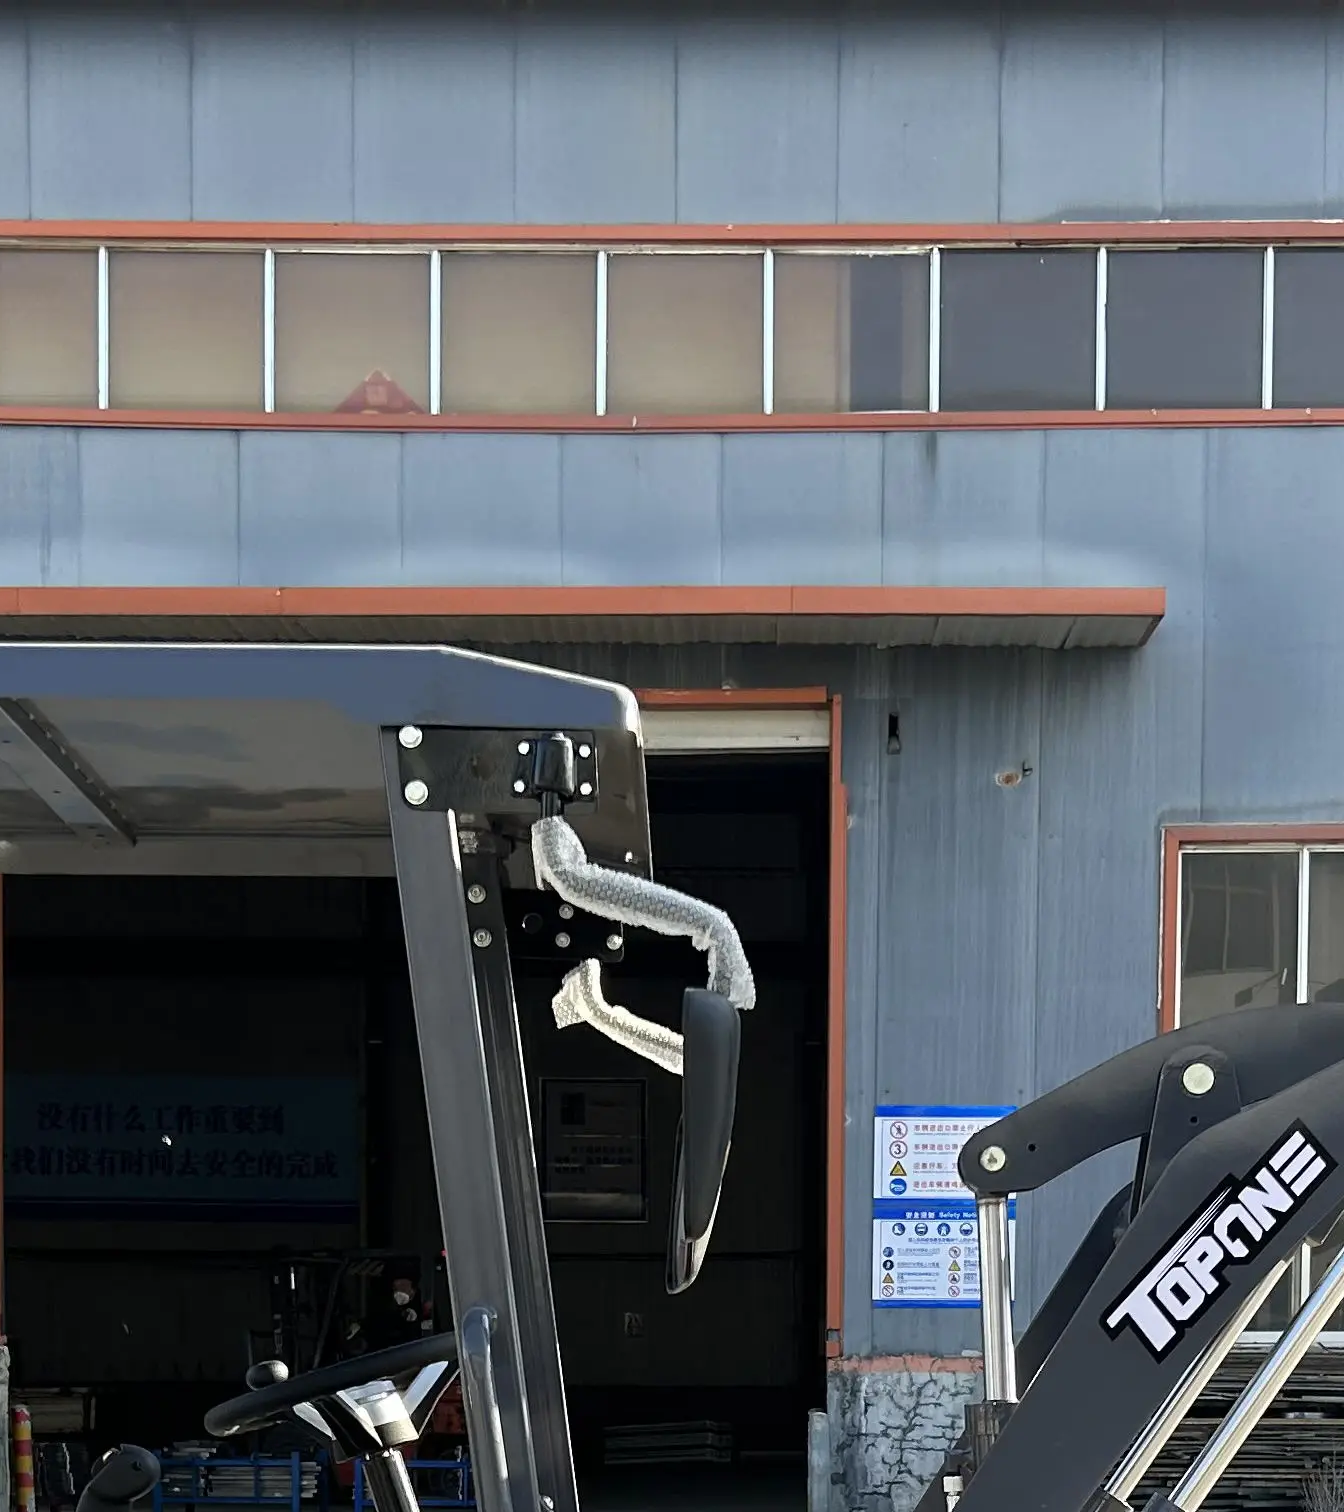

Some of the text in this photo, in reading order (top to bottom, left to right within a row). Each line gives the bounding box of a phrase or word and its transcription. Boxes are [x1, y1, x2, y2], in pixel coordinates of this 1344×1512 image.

[3, 1146, 339, 1180] 我们没有时间去安全的完成
[894, 1144, 901, 1155] 3
[1106, 1130, 1327, 1352] TOPONE
